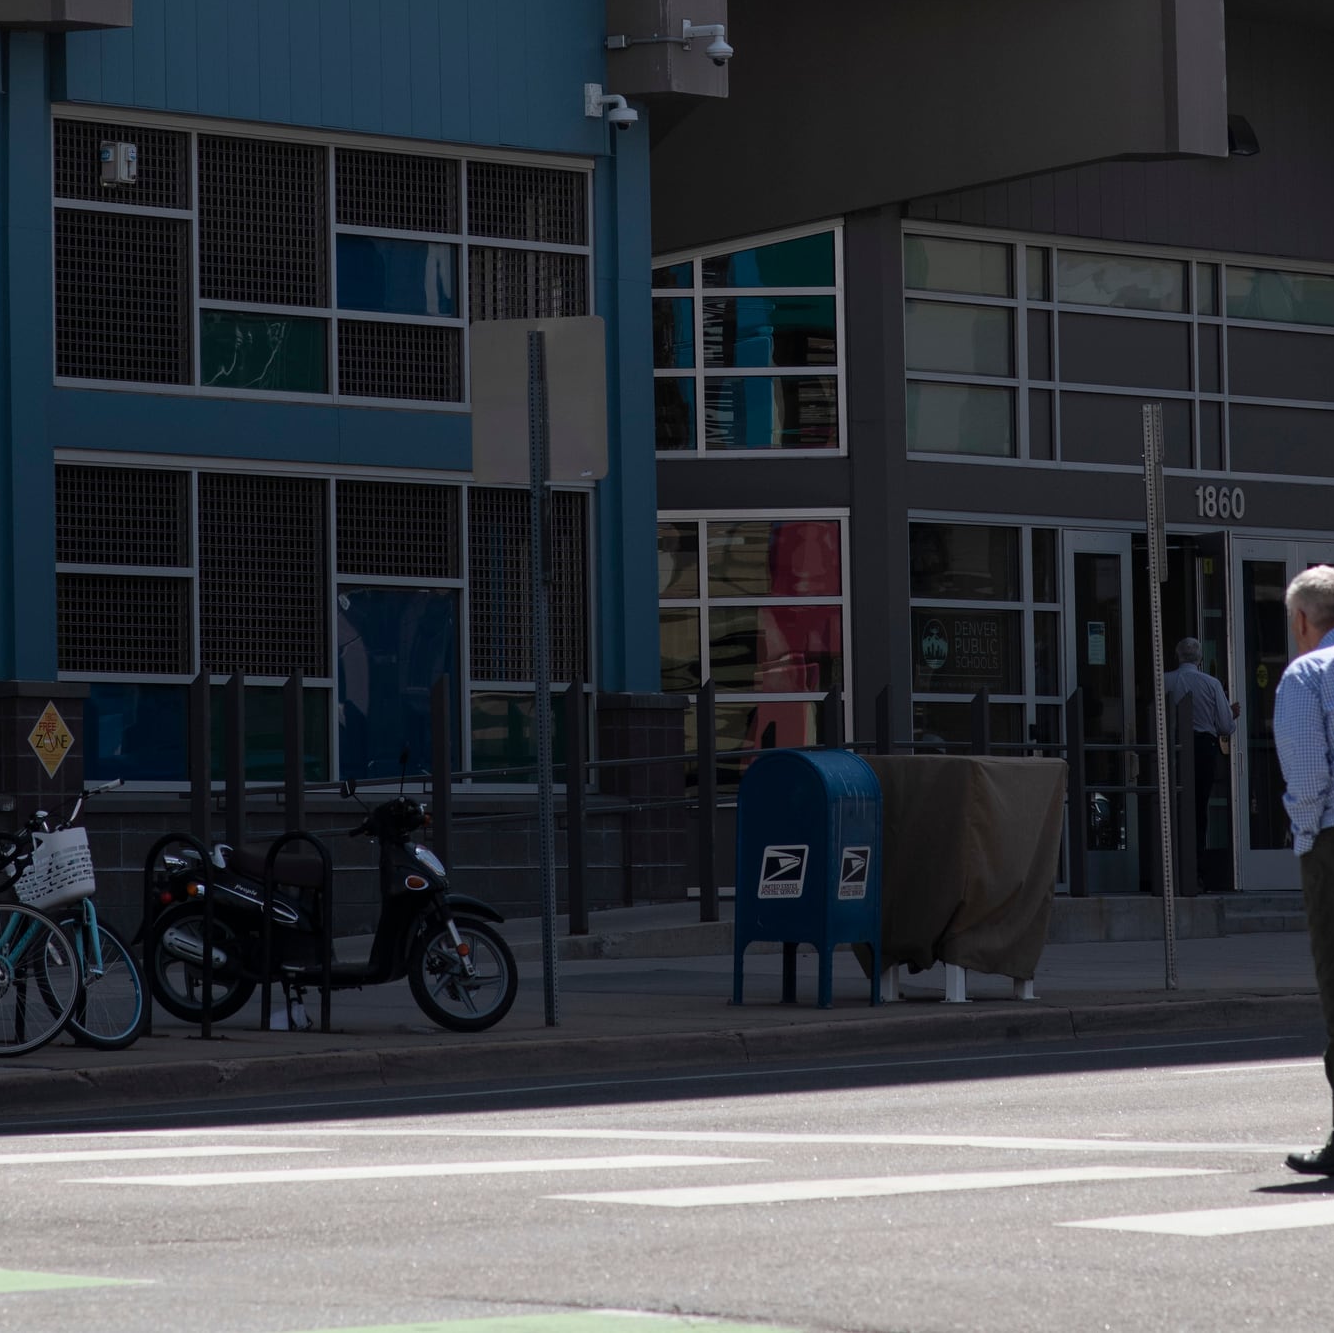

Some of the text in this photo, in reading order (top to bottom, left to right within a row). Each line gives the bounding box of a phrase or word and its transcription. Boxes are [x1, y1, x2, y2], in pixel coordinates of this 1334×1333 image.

[1195, 485, 1245, 519] 1860
[954, 620, 996, 637] DENVER
[954, 638, 998, 655] PUBLIC
[955, 656, 998, 669] SCHOOLS
[38, 722, 57, 732] FREE
